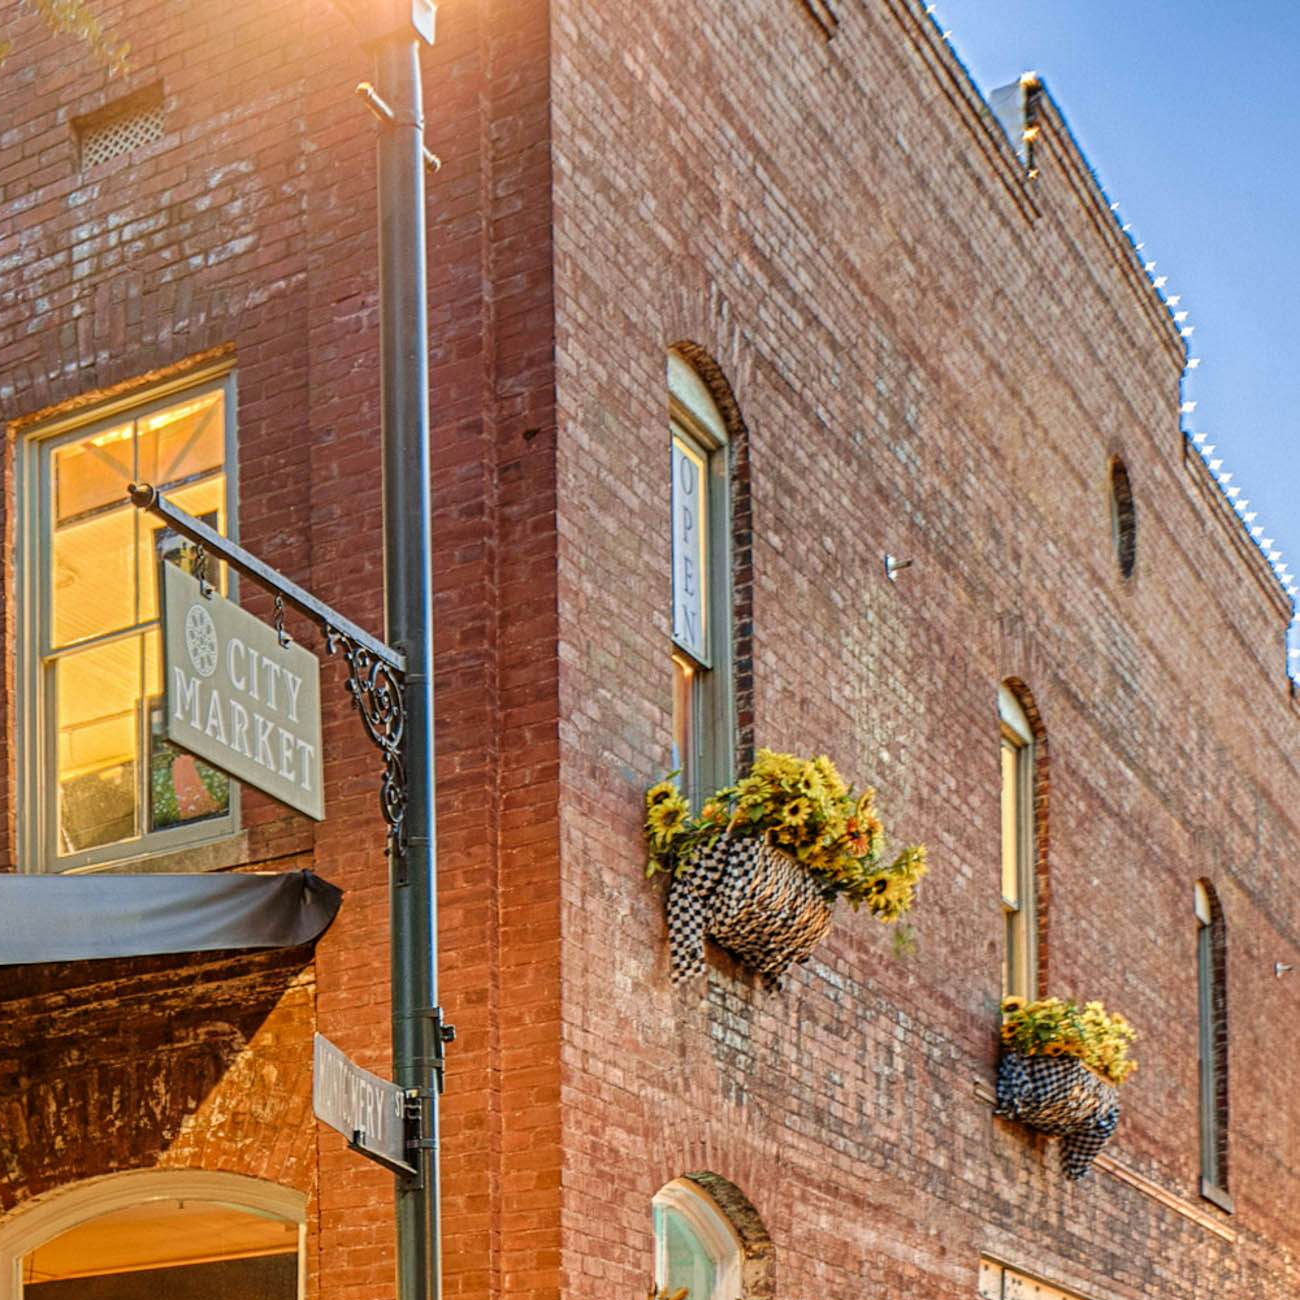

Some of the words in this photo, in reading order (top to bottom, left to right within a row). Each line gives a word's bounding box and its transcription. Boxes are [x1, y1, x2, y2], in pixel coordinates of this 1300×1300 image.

[680, 455, 696, 645] OPEN
[172, 665, 316, 793] MARKET
[226, 637, 304, 723] CITY
